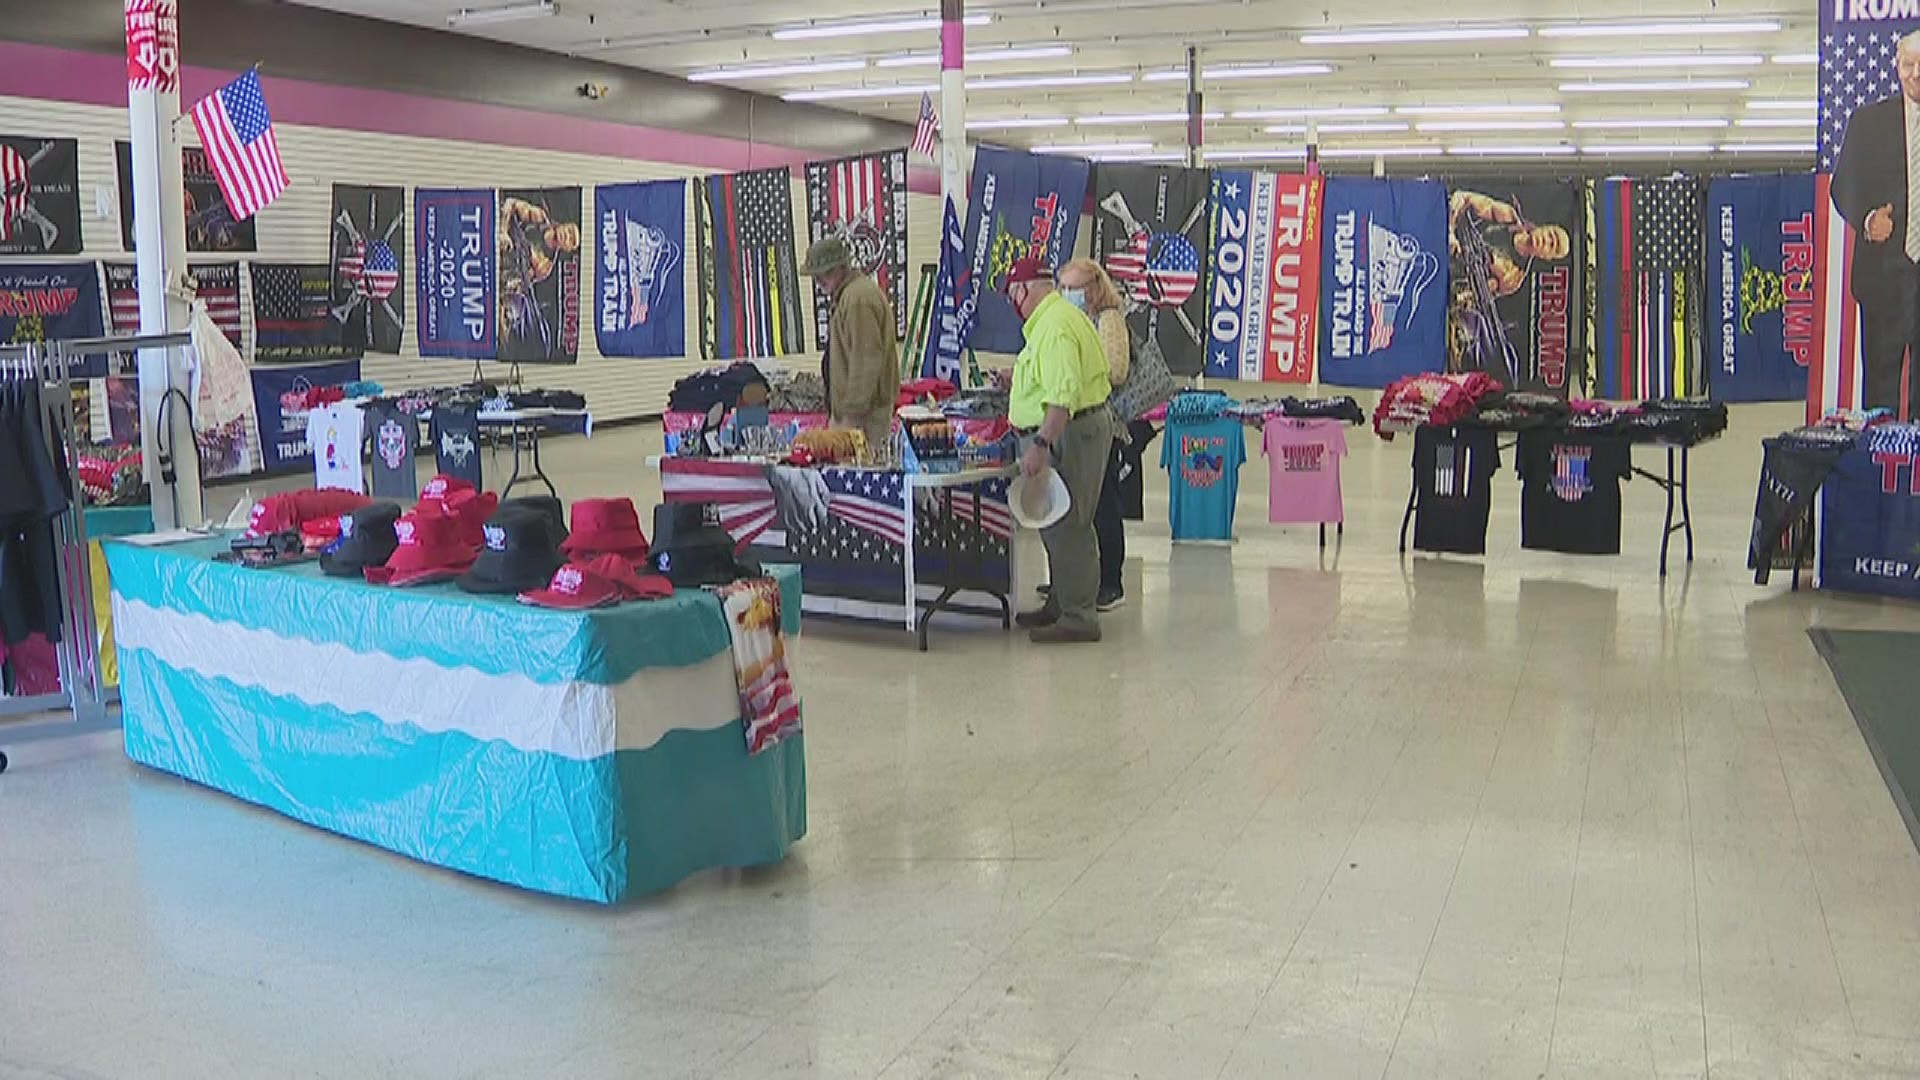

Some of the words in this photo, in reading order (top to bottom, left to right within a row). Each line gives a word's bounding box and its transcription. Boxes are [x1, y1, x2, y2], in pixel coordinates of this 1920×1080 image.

[427, 207, 436, 238] KEEP
[982, 173, 996, 212] KEEP
[1257, 181, 1271, 226] KEEP
[602, 209, 619, 272] TRUMP
[971, 212, 991, 276] AMERICA
[1333, 209, 1356, 285] TRUMP
[1721, 205, 1734, 247] KEEP
[427, 240, 436, 294] AMERICA
[461, 206, 484, 340] TRUMP
[1211, 207, 1247, 342] 2020
[1250, 230, 1268, 306] AMERICA
[1268, 183, 1307, 374] TRUMP
[1720, 250, 1734, 320] AMERICA
[1781, 212, 1813, 367] TRUMP
[0, 287, 79, 317] RUMP
[563, 255, 581, 355] TRUMP
[602, 275, 619, 332] TRAIN
[1331, 287, 1353, 359] TRAIN
[1537, 265, 1569, 388] TRUMP
[1296, 313, 1310, 363] Donald
[1722, 323, 1735, 375] GREAT
[277, 439, 314, 461] TRUM
[1854, 556, 1909, 577] KEEP
